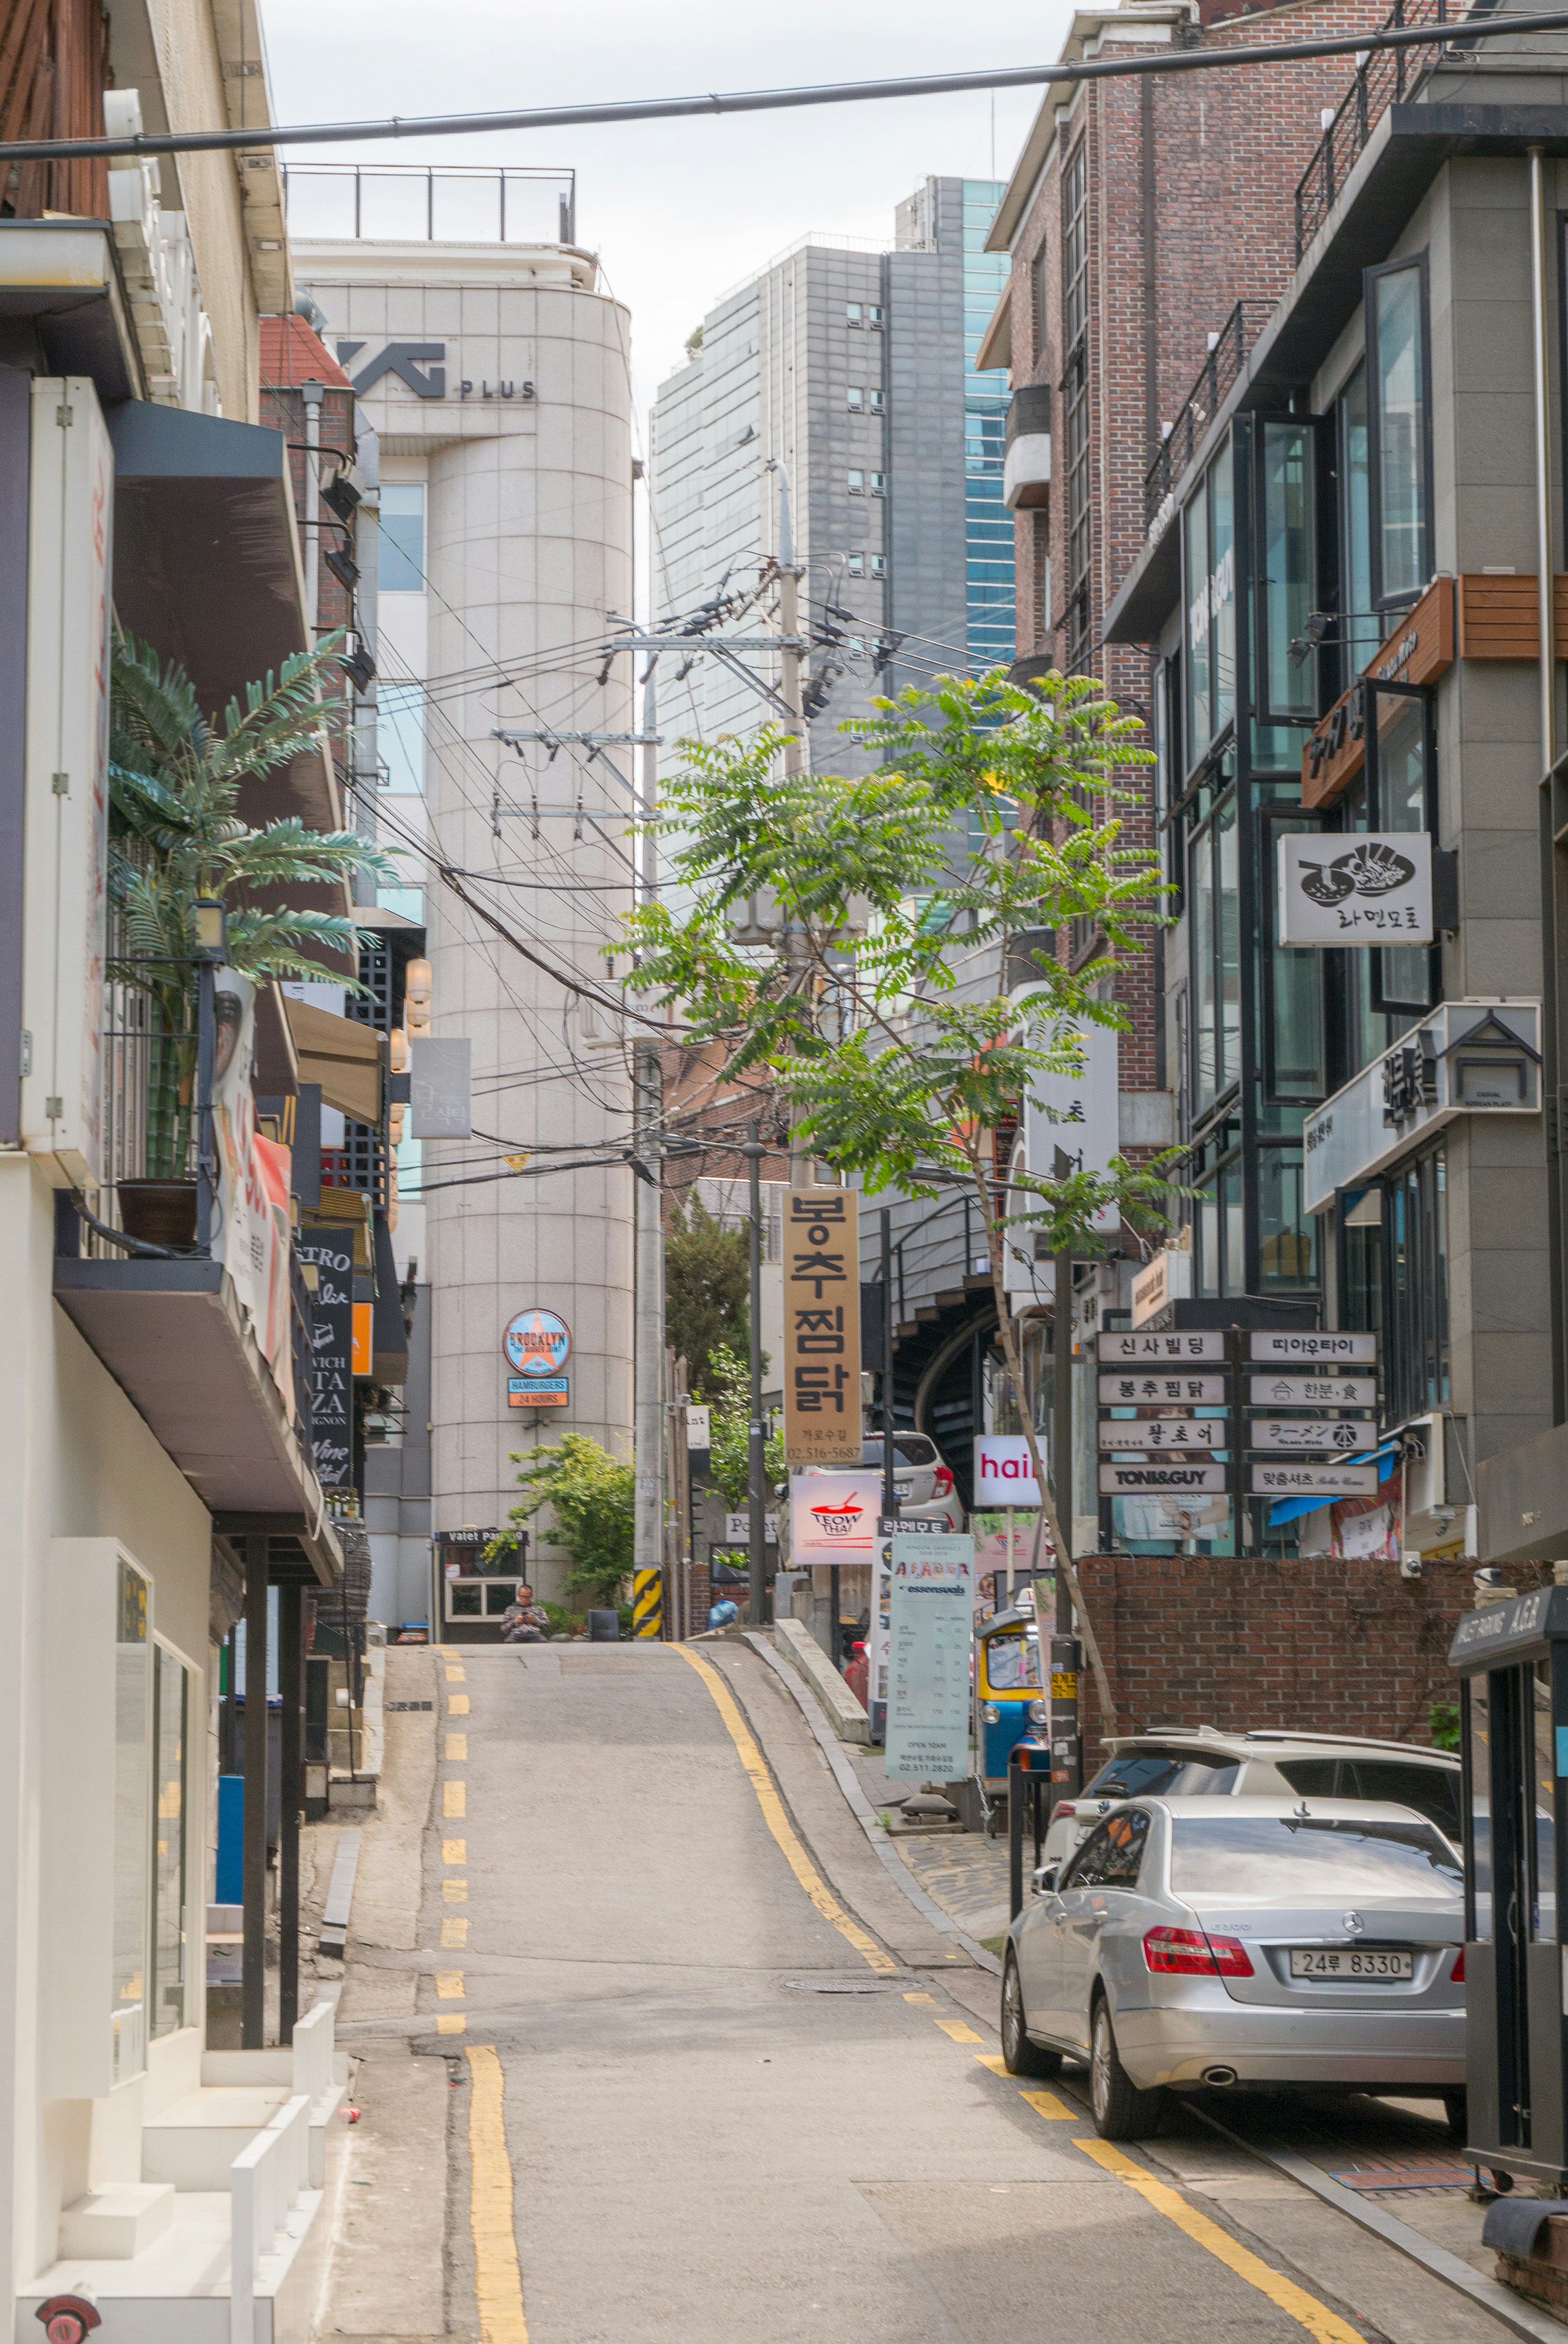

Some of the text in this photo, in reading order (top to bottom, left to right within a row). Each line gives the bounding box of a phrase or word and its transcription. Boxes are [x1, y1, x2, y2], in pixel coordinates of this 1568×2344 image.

[461, 380, 535, 399] PLUS
[1336, 908, 1420, 930] 라멘모토
[790, 1196, 850, 1413] 봉추찜닭
[510, 1332, 566, 1347] BROOKLYN
[1119, 1337, 1204, 1355] 신사빌딩
[1273, 1338, 1353, 1355] 띠아우타이
[512, 1381, 565, 1390] HAMBURGERS
[1119, 1380, 1205, 1398] 봉추찜닭
[519, 1394, 558, 1404] 24 HOURS
[802, 1429, 847, 1442] 가로수길
[1269, 1424, 1330, 1437] ラーメン
[787, 1447, 860, 1460] 02.516-5687
[1115, 1470, 1208, 1486] TONI&GUY
[1263, 1472, 1314, 1486] 맞춤셔츠
[811, 1513, 862, 1525] TEOW
[821, 1523, 853, 1534] THAI
[449, 1531, 479, 1542] Valet
[1303, 1953, 1401, 1974] 24루 8330
